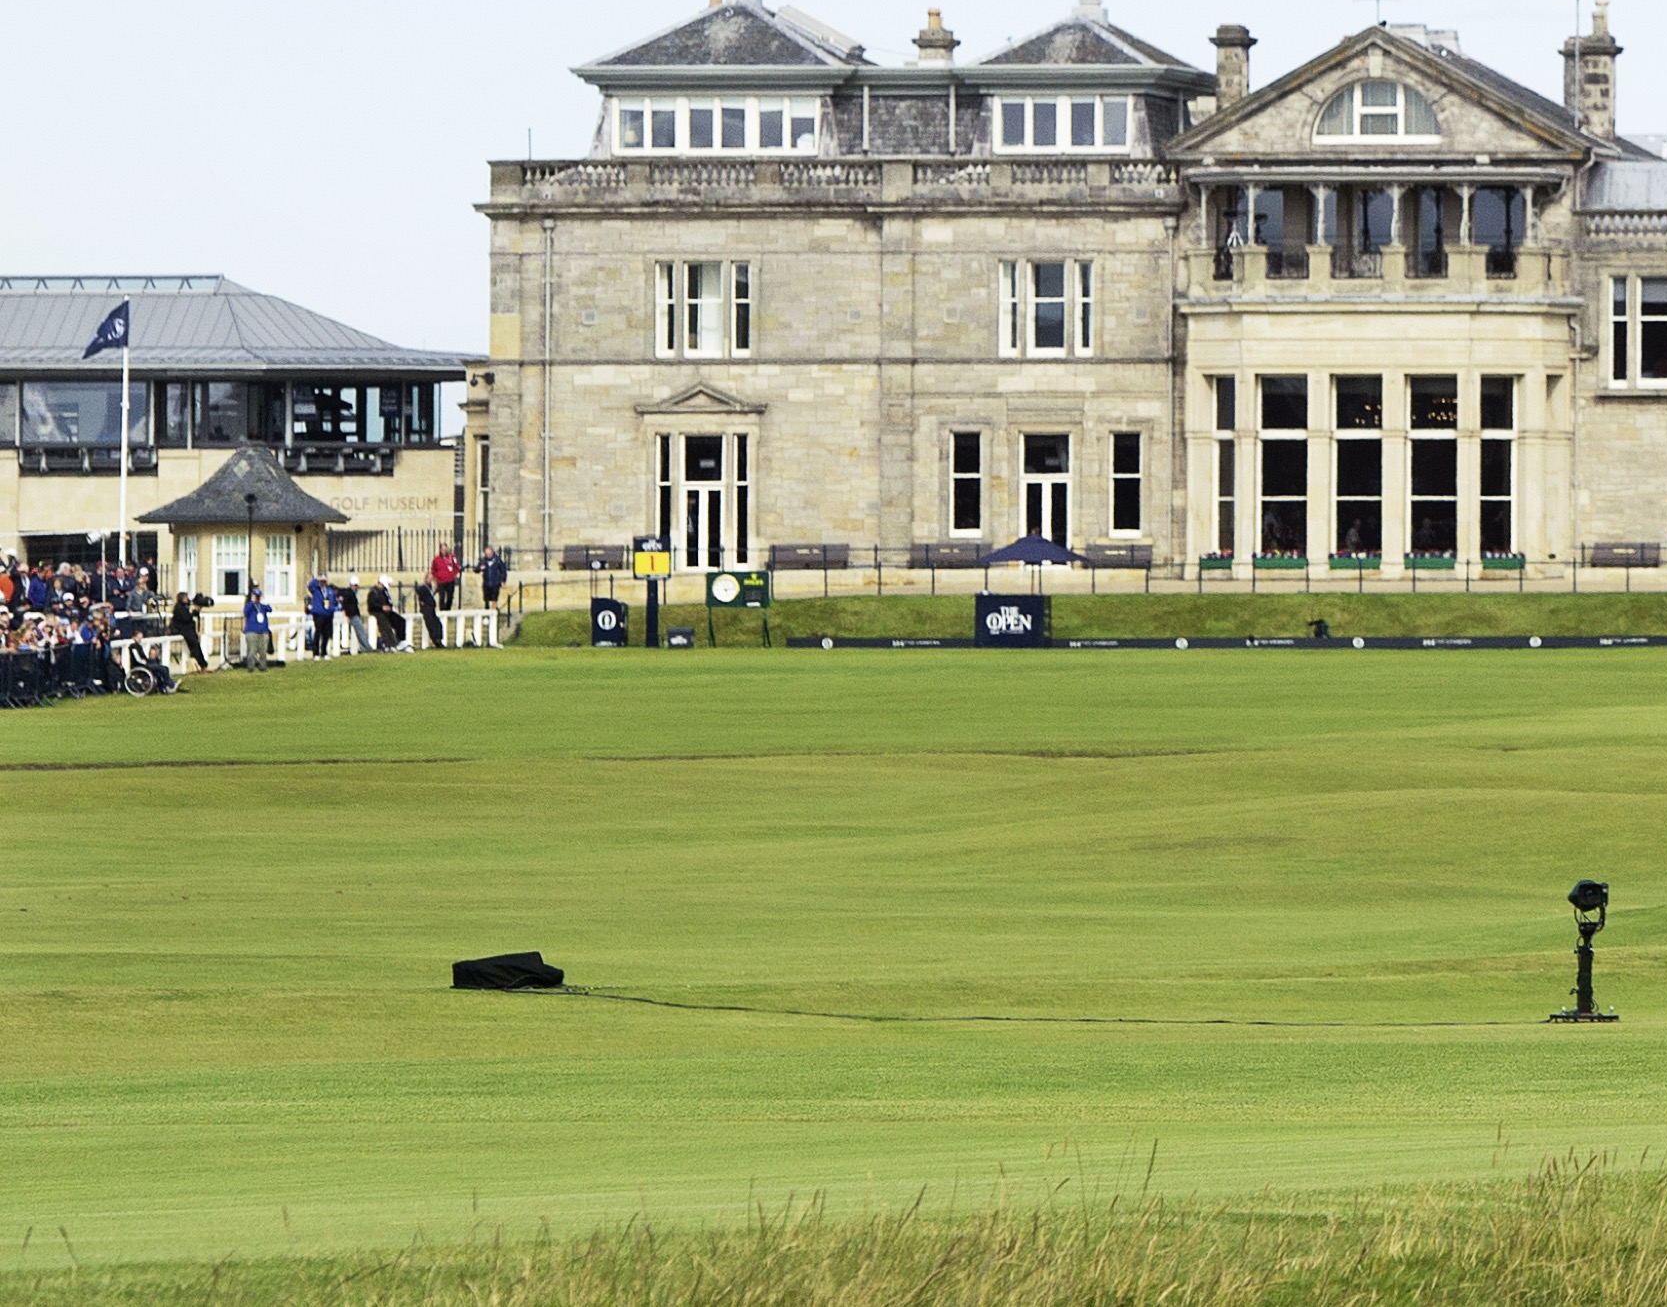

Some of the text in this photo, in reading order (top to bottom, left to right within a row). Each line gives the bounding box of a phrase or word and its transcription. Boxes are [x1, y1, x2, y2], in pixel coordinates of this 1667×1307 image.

[330, 496, 439, 511] GOLF MUSEUM
[650, 555, 655, 572] 1
[1000, 606, 1020, 616] THE
[986, 612, 1032, 631] OPEN
